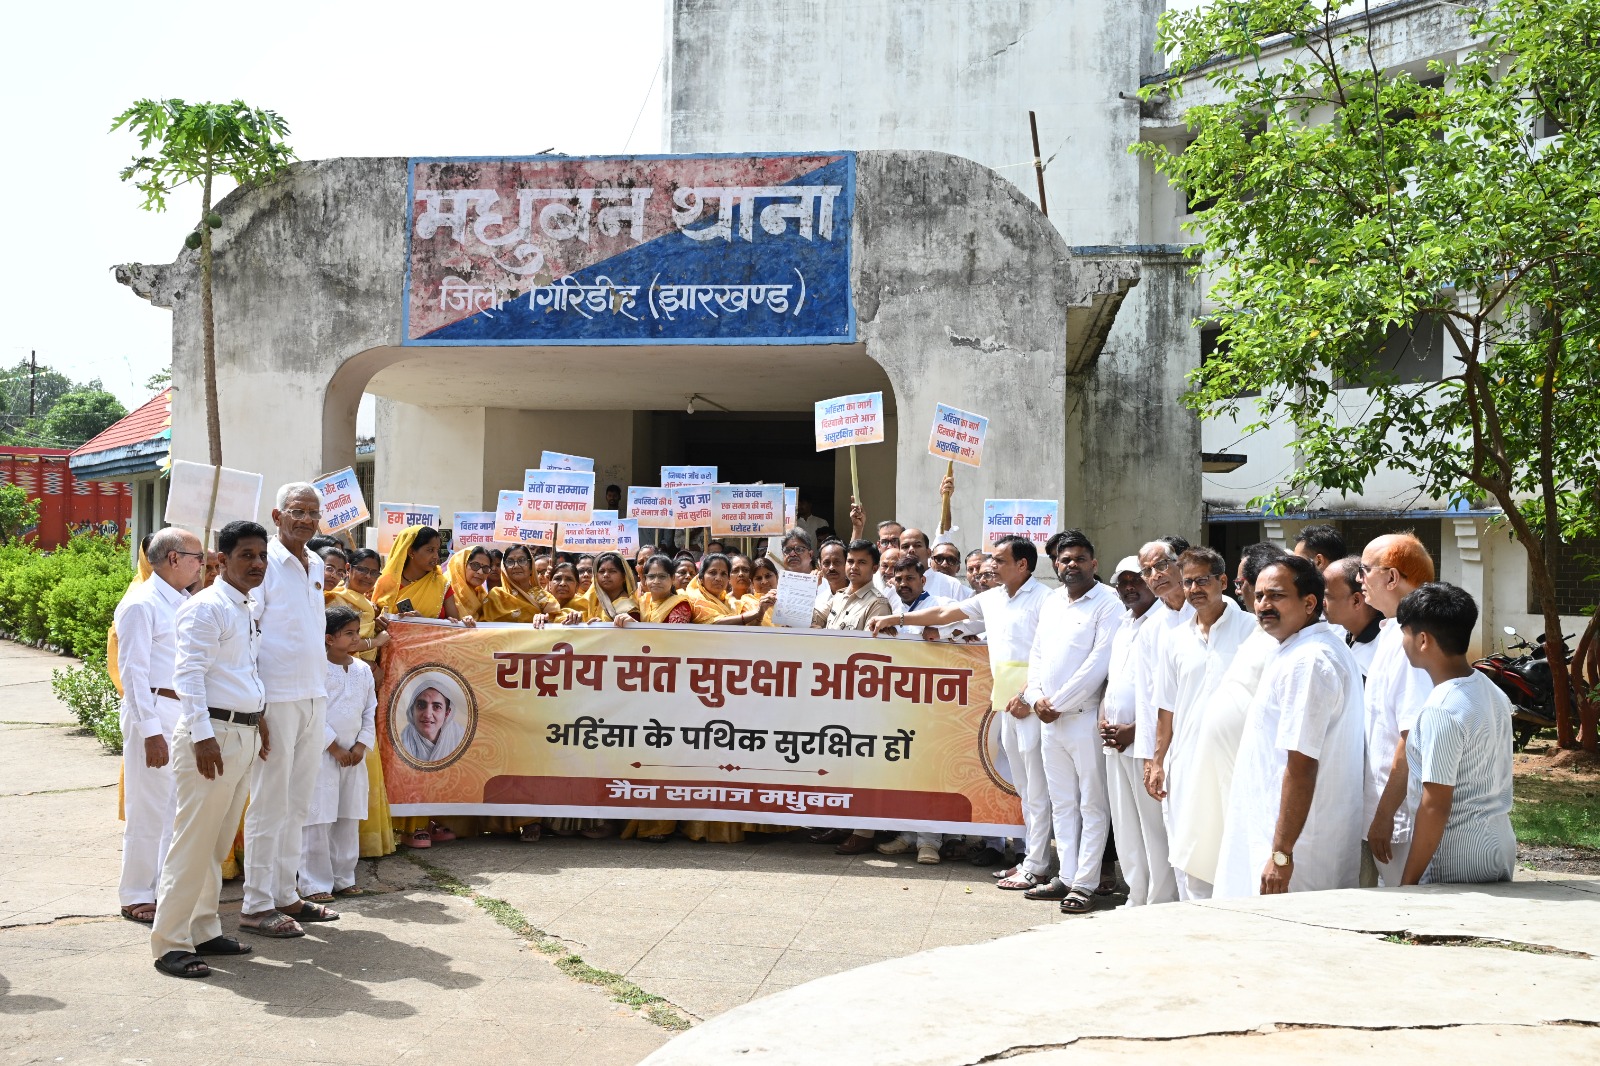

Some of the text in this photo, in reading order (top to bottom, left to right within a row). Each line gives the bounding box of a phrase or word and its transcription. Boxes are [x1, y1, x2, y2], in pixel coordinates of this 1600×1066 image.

[415, 185, 842, 275] मधुबन थाना
[529, 274, 641, 321] गिरिडीह
[649, 267, 807, 320] (झारखण्ड)
[825, 398, 873, 415] अहिंसा का मार्ग
[844, 413, 859, 425] वाले
[860, 413, 876, 423] आज
[942, 412, 960, 426] अहिंसा
[823, 428, 854, 444] असुरक्षित
[854, 425, 869, 437] क्यों
[967, 434, 980, 446] आज
[528, 482, 590, 496] संतों का सम्मान
[731, 488, 763, 499] संत केवल
[527, 499, 541, 511] राष्ट्र
[542, 500, 554, 510] का
[555, 500, 587, 512] सम्मान
[678, 494, 696, 509] युवा
[732, 502, 751, 510] समाज
[751, 500, 760, 510] की
[387, 511, 405, 525] हम
[504, 510, 515, 522] को
[676, 510, 688, 521] संत
[738, 511, 747, 521] की
[987, 512, 1053, 526] अहिंसा की रक्षा में
[460, 520, 479, 531] विहार
[459, 533, 484, 545] सुरक्षित
[519, 528, 544, 541] सुरक्षा
[544, 528, 554, 541] दो
[493, 642, 972, 709] राष्ट्रीय संत सुरक्षा अभियान
[545, 716, 916, 765] अहिंसा के पथिक सुरक्षित हों
[606, 780, 854, 812] जैन समाज मधुबन
